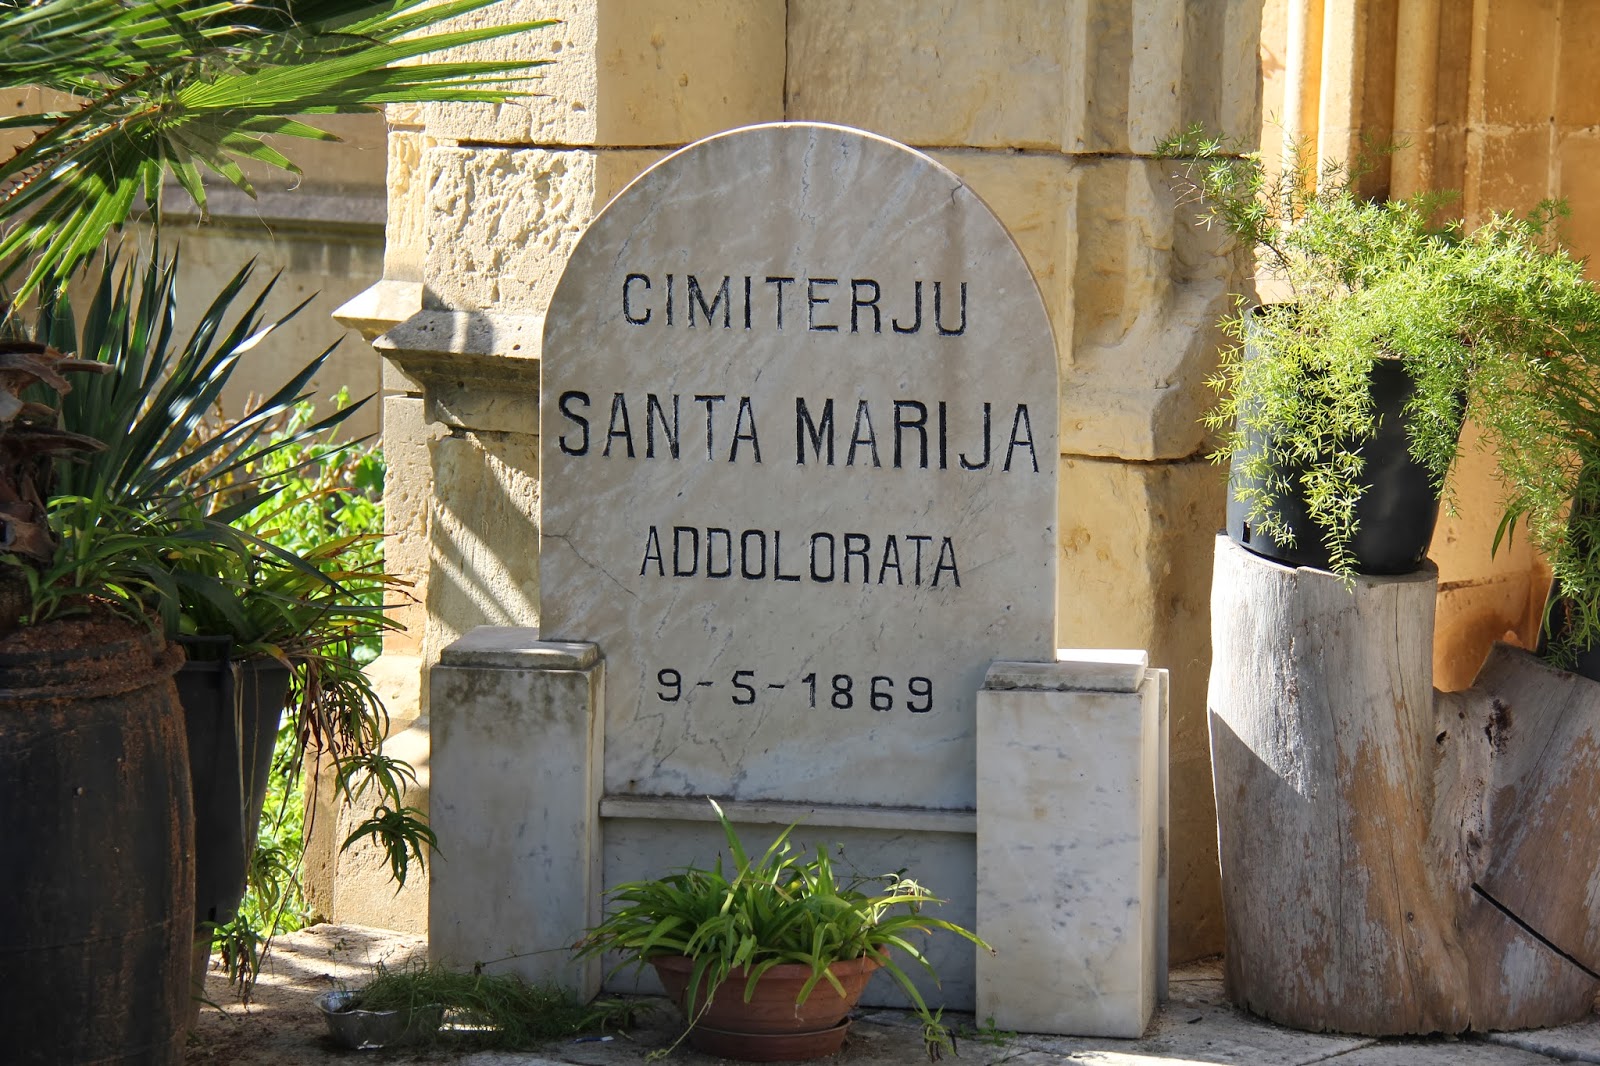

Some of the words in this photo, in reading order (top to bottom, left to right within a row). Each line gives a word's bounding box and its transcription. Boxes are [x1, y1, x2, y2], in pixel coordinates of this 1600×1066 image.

[622, 273, 968, 338] CIMITERJU
[558, 390, 763, 464] SANTA
[795, 397, 1040, 473] MARIJA
[639, 525, 963, 588] ADDOLORATA
[656, 668, 934, 714] 9-5-1869
